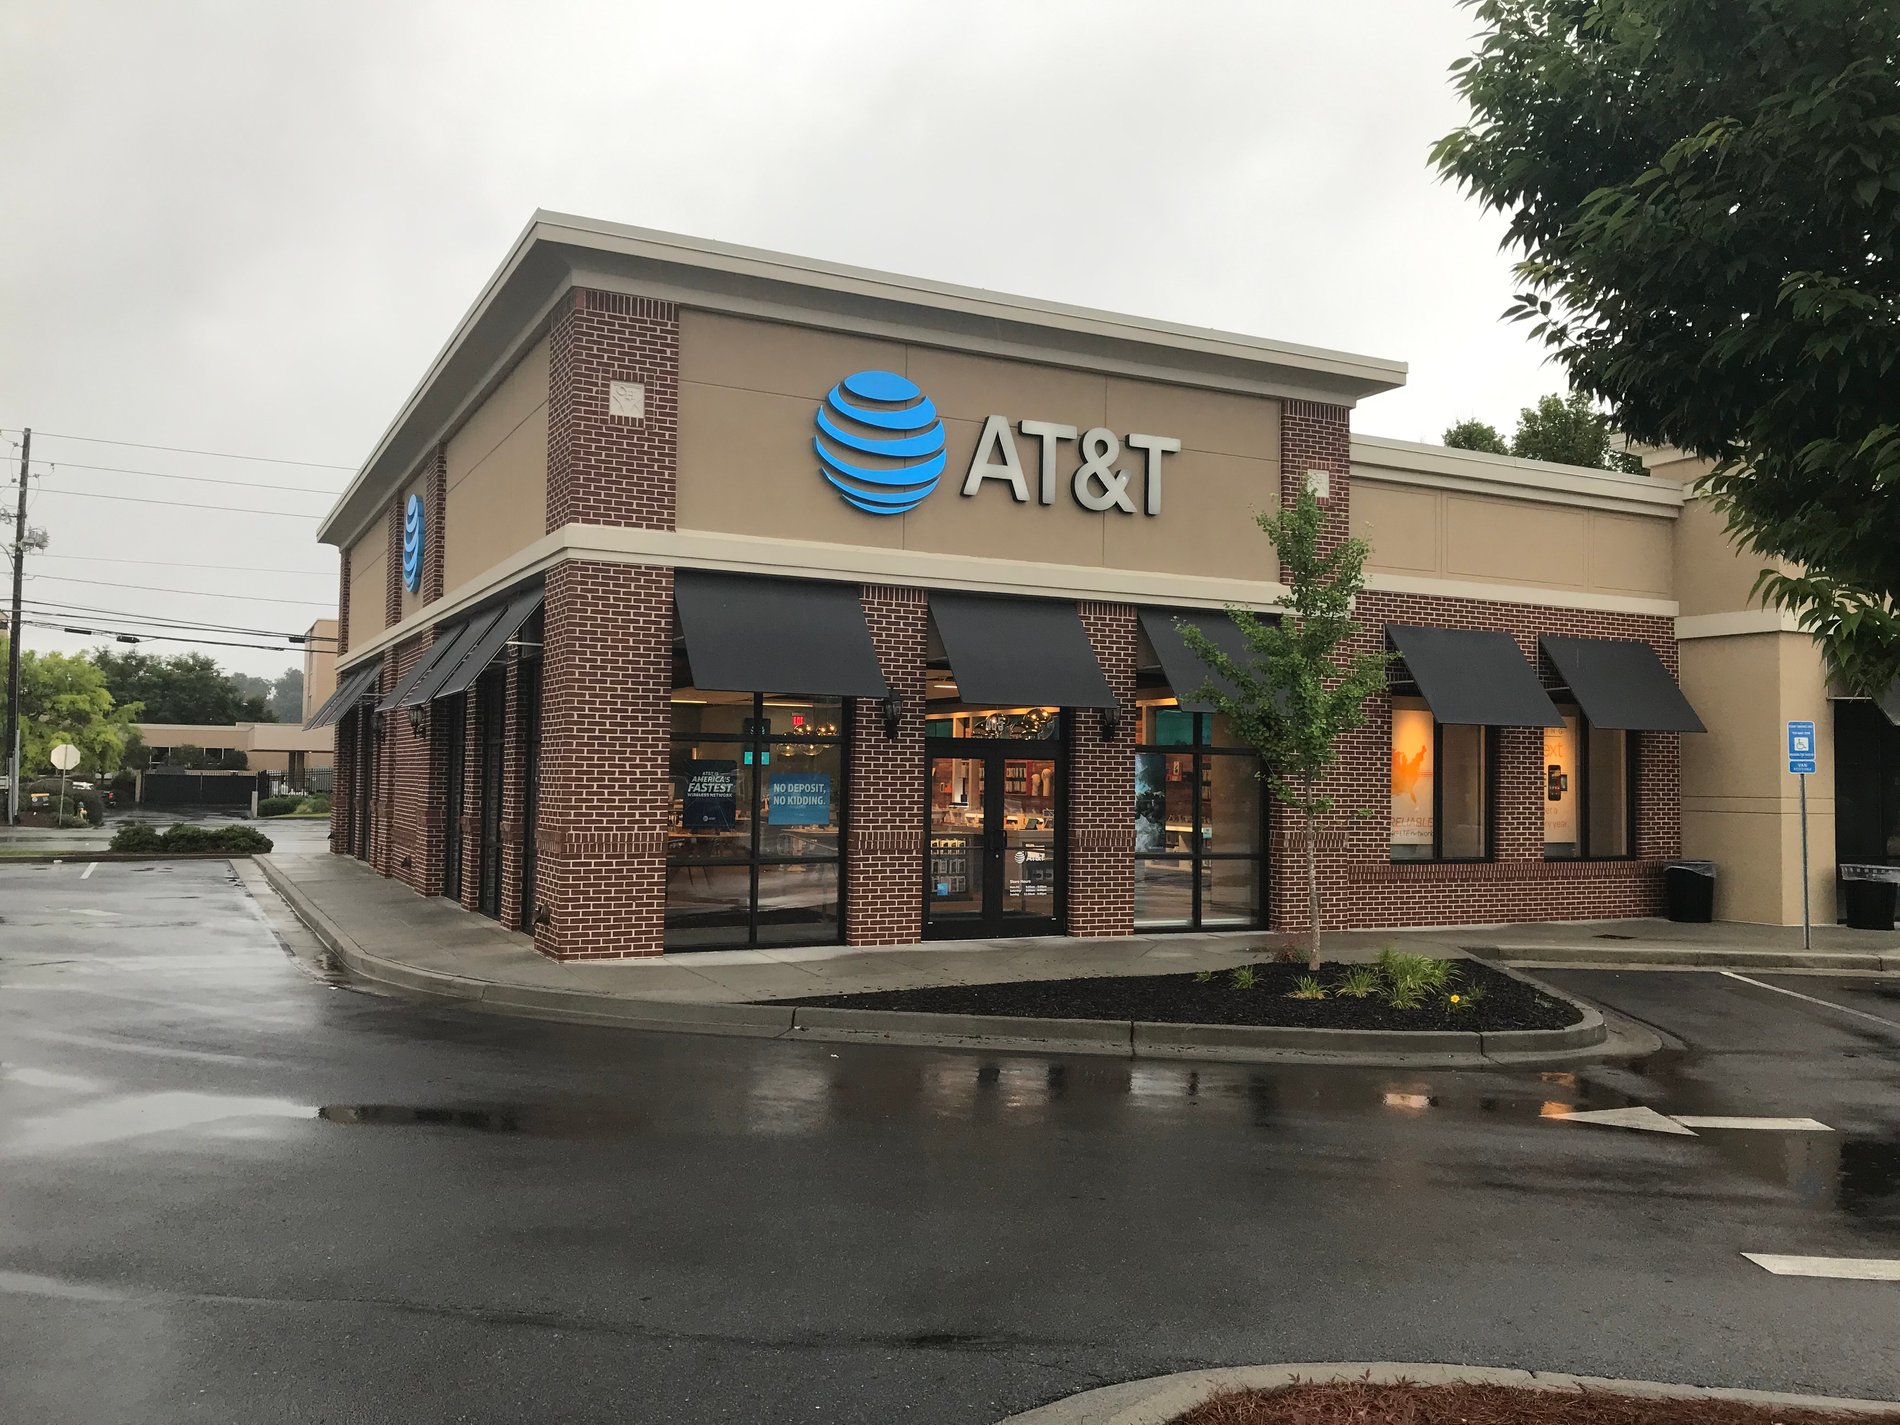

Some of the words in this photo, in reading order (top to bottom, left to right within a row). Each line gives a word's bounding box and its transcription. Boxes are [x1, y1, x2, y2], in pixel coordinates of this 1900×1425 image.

[960, 414, 1182, 517] AT&T
[687, 783, 733, 792] FASTEST
[773, 783, 787, 793] NO
[787, 783, 827, 795] DEPOSIT,
[773, 795, 787, 805] NO
[787, 796, 826, 805] KIDDING.
